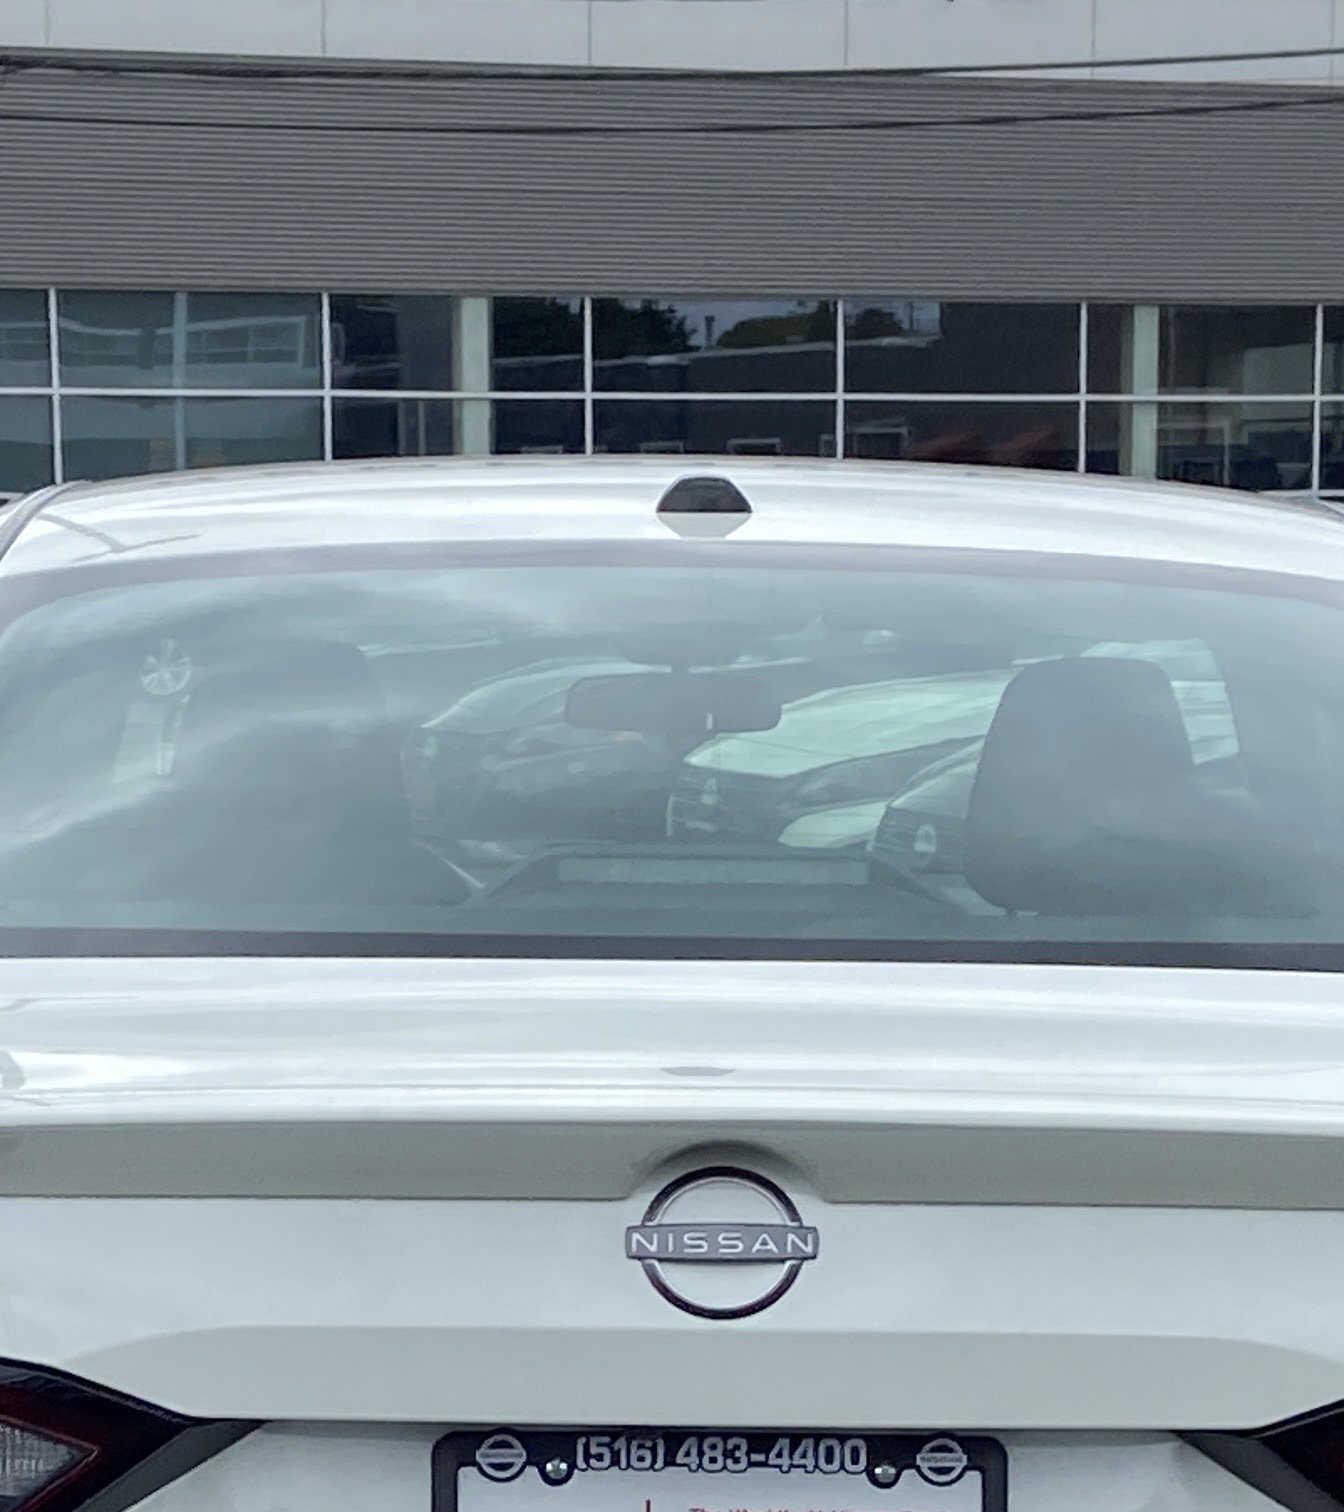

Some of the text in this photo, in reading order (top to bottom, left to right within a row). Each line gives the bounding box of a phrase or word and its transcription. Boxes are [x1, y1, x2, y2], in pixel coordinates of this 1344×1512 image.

[630, 1231, 815, 1254] NISSAN
[575, 1435, 868, 1474] (516) 483-4400
